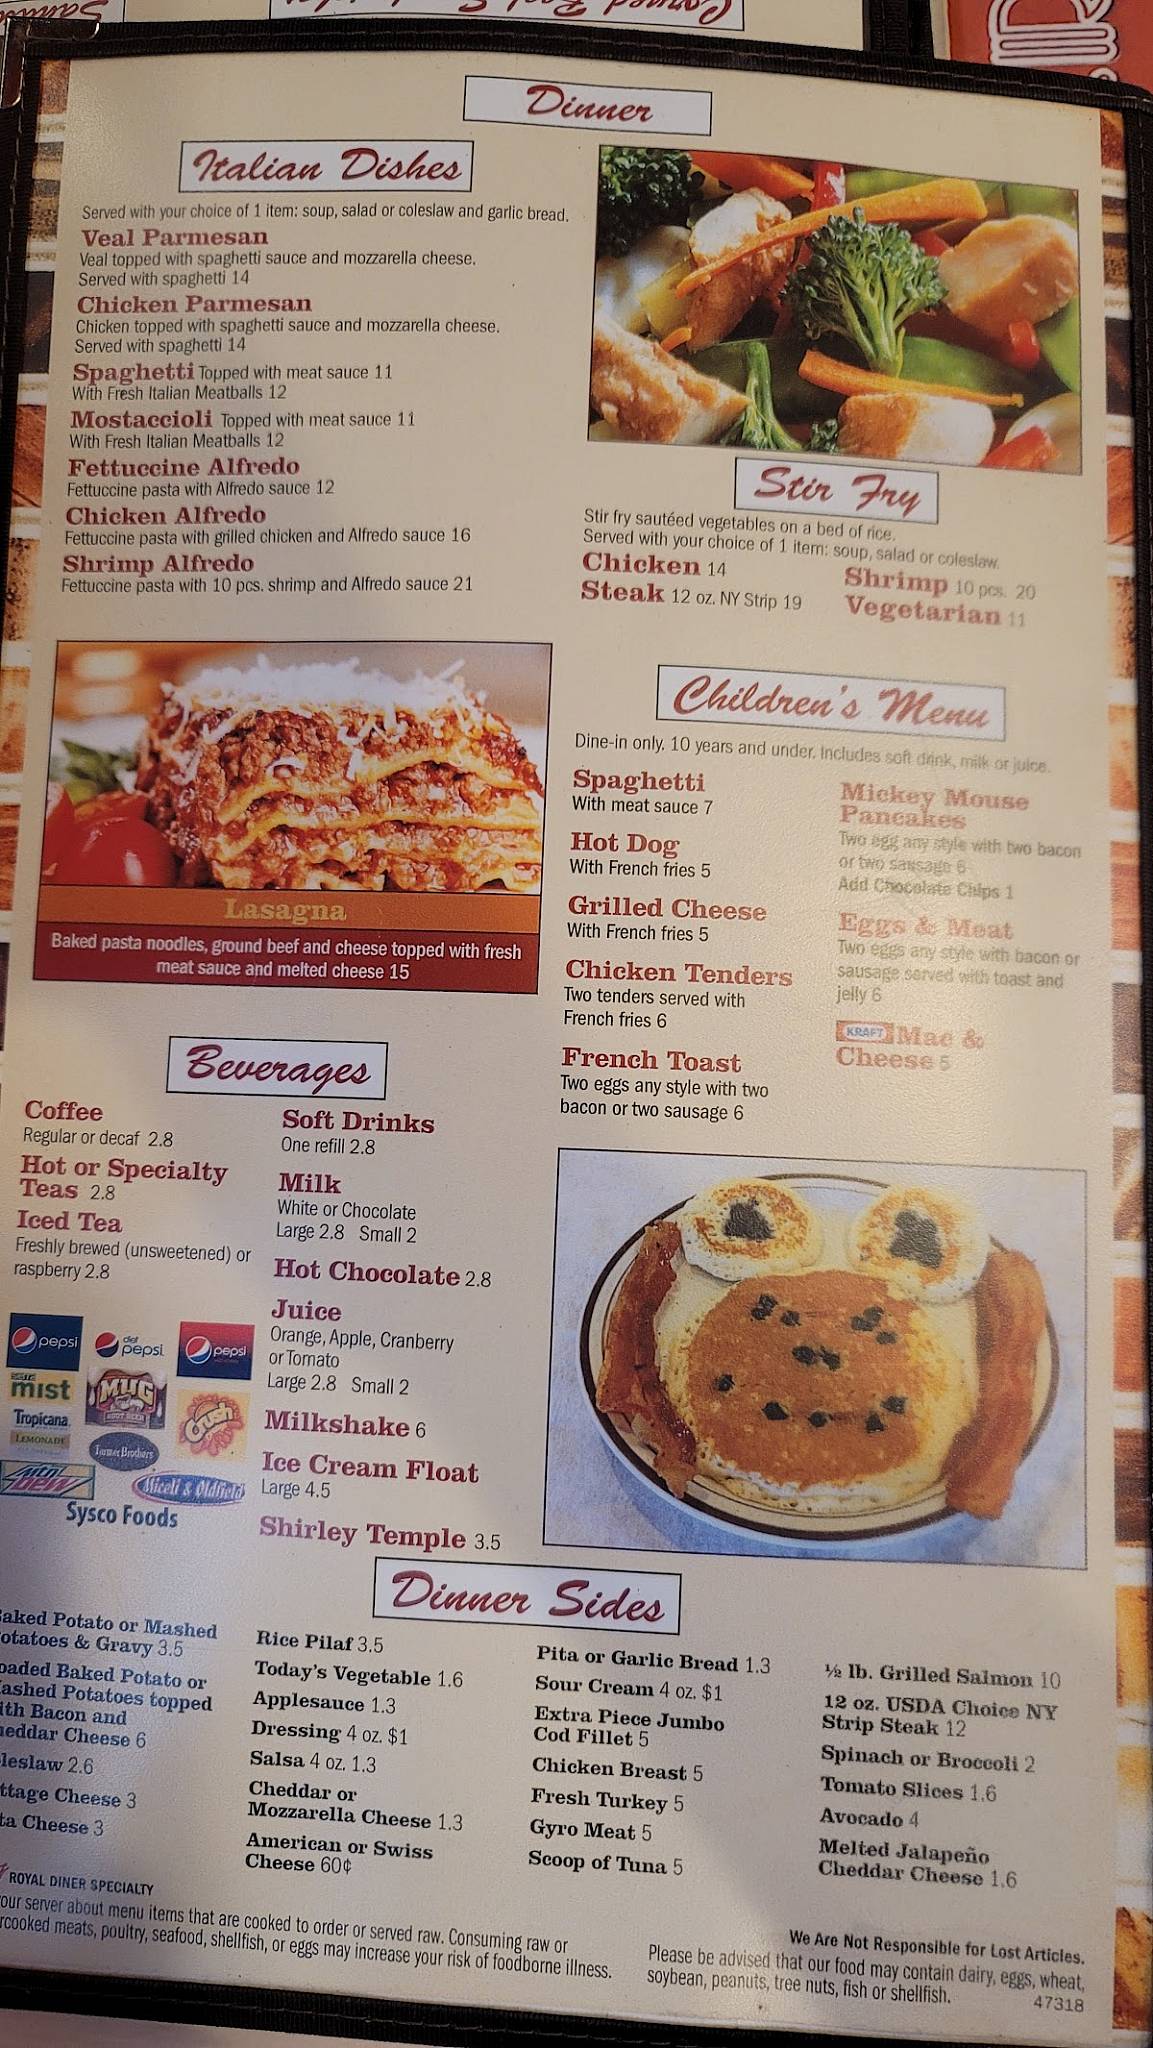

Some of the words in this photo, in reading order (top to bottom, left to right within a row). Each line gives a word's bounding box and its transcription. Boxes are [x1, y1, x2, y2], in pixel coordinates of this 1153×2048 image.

[526, 84, 654, 124] Dinner
[193, 149, 324, 184] Italian
[341, 147, 464, 182] Dishes
[81, 229, 134, 247] Veal
[142, 229, 268, 246] Parmesan
[78, 296, 178, 314] Chicken
[185, 295, 312, 312] Parmesan
[72, 363, 195, 386] Spaghetti
[198, 365, 248, 383] Topped
[254, 365, 281, 379] with
[287, 366, 322, 379] meat
[327, 368, 368, 379] sauce
[376, 364, 391, 379] 11
[71, 386, 102, 400] With
[107, 386, 143, 400] Fresh
[149, 385, 189, 400] Italian
[196, 385, 262, 399] Meatballs
[270, 384, 286, 399] 12
[70, 410, 213, 428] Mostaccioli
[68, 458, 200, 477] Fettuccine
[208, 456, 299, 476] Alfredo
[754, 466, 833, 501] Stir
[852, 474, 921, 517] Fry
[66, 507, 167, 525] Chicken
[174, 505, 266, 524] Alfredo
[63, 555, 154, 578] Shrimp
[162, 553, 254, 572] Alfredo
[583, 552, 700, 575] Chicken
[709, 562, 725, 576] 14
[845, 567, 947, 597] Shrimp
[956, 579, 974, 594] 10
[581, 580, 664, 602] Steak
[673, 589, 690, 603] 12
[696, 592, 716, 606] oz.
[720, 590, 741, 606] NY
[744, 593, 777, 611] Strip
[784, 595, 801, 610] 19
[846, 595, 999, 624] Vegetarian
[673, 675, 862, 722] Children's
[879, 689, 992, 729] Menu
[573, 768, 705, 796] Spaghetti
[572, 795, 605, 811] With
[612, 798, 649, 812] meat
[654, 802, 698, 814] sauce
[705, 800, 712, 814] 7
[840, 782, 936, 809] Mickey
[944, 788, 1030, 811] Mouse
[840, 804, 967, 830] Pancakes
[571, 832, 618, 852] Hot
[627, 834, 680, 859] Dog
[224, 898, 347, 926] Lasagna
[569, 896, 663, 917] Grilled
[672, 899, 766, 920] Cheese
[838, 912, 906, 938] Eggs
[915, 916, 936, 936] &
[947, 917, 1014, 940] Meat
[157, 960, 194, 974] meat
[198, 963, 241, 975] sauce
[245, 961, 272, 976] and
[278, 962, 327, 977] melted
[332, 962, 384, 979] cheese
[390, 964, 409, 979] 15
[566, 960, 676, 981] Chicken
[685, 964, 792, 986] Tenders
[846, 1026, 884, 1038] KRAFT
[896, 1025, 953, 1047] Mac
[961, 1028, 985, 1050] &
[187, 1044, 372, 1094] Beverages
[562, 1047, 658, 1069] French
[667, 1051, 741, 1072] Toast
[835, 1046, 934, 1070] Cheese
[25, 1100, 103, 1121] Coffee
[283, 1110, 334, 1129] Soft
[342, 1112, 434, 1133] Drinks
[20, 1155, 66, 1175] Hot
[75, 1162, 100, 1176] or
[108, 1157, 228, 1188] Specialty
[20, 1178, 78, 1199] Teas
[91, 1185, 115, 1200] 2.8
[278, 1173, 341, 1196] Milk
[17, 1210, 70, 1230] Iced
[78, 1213, 122, 1232] Tea
[274, 1258, 320, 1279] Hot
[329, 1261, 460, 1286] Chocolate
[465, 1271, 491, 1287] 2.8
[272, 1299, 341, 1321] Juice
[39, 1336, 79, 1350] pepsi
[121, 1344, 163, 1358] pepsi
[213, 1345, 247, 1358] pepsi
[11, 1379, 71, 1401] mist
[100, 1378, 155, 1407] MUG
[13, 1408, 69, 1428] Tropicana
[265, 1410, 409, 1437] Milkshake
[415, 1422, 426, 1438] 6
[263, 1452, 300, 1472] Ice
[310, 1455, 397, 1478] Cream
[406, 1460, 479, 1483] Float
[262, 1479, 300, 1499] Large
[305, 1482, 330, 1498] 4.5
[66, 1501, 117, 1527] Sysco
[123, 1504, 178, 1528] Foods
[260, 1516, 358, 1547] Shirley
[367, 1524, 466, 1553] Temple
[475, 1534, 500, 1550] 3.5
[391, 1569, 531, 1613] Dinner
[548, 1578, 665, 1622] Sides
[256, 1630, 298, 1647] Rice
[305, 1634, 354, 1651] Pilaf
[358, 1636, 383, 1653] 3.5
[537, 1646, 579, 1662] Pita
[585, 1653, 605, 1663] or
[612, 1650, 673, 1668] Garlic
[680, 1655, 738, 1672] Bread
[747, 1657, 770, 1673] 1.3
[63, 1684, 144, 1706] Potatoes
[149, 1691, 213, 1714] topped
[253, 1691, 364, 1711] Applesauce
[372, 1697, 395, 1714] 1.3
[251, 1720, 341, 1744] Dressing
[347, 1725, 356, 1741] 4
[362, 1730, 383, 1743] oz.
[388, 1727, 407, 1745] $1
[821, 1776, 896, 1796] Tomato
[903, 1782, 963, 1800] Slices
[972, 1784, 996, 1801] 1.6
[820, 1807, 903, 1828] Avocado
[910, 1812, 918, 1827] 4
[529, 1850, 584, 1872] Scoop
[592, 1855, 611, 1870] of
[616, 1856, 667, 1874] Tuna
[674, 1859, 682, 1875] 5
[9, 1871, 46, 1887] ROYAL
[49, 1875, 87, 1891] DINER
[90, 1879, 154, 1896] SPECIALTY
[789, 1929, 810, 1945] We
[812, 1932, 838, 1950] Are
[844, 1934, 869, 1950] Not
[874, 1936, 960, 1955] Responsible
[965, 1941, 986, 1957] for
[991, 1944, 1021, 1959] Lost
[1024, 1945, 1084, 1968] Articles.
[1034, 1996, 1084, 2012] 47318
